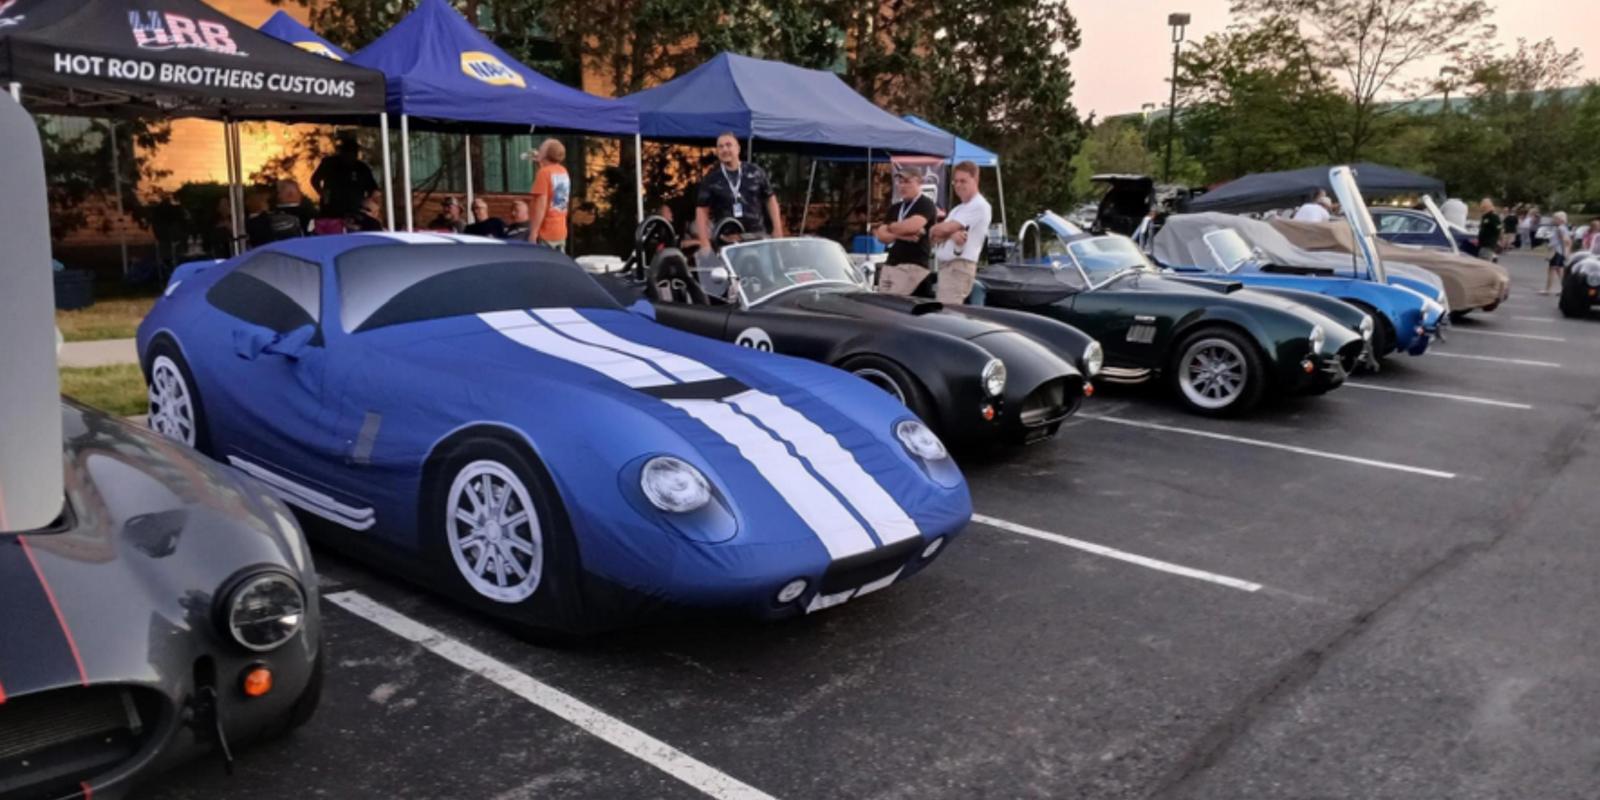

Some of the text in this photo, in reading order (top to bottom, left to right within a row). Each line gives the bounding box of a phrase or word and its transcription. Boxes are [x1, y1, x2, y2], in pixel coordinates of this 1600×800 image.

[128, 10, 238, 54] HRB
[53, 52, 356, 98] HOT ROD BROTHERS CUSTOMS
